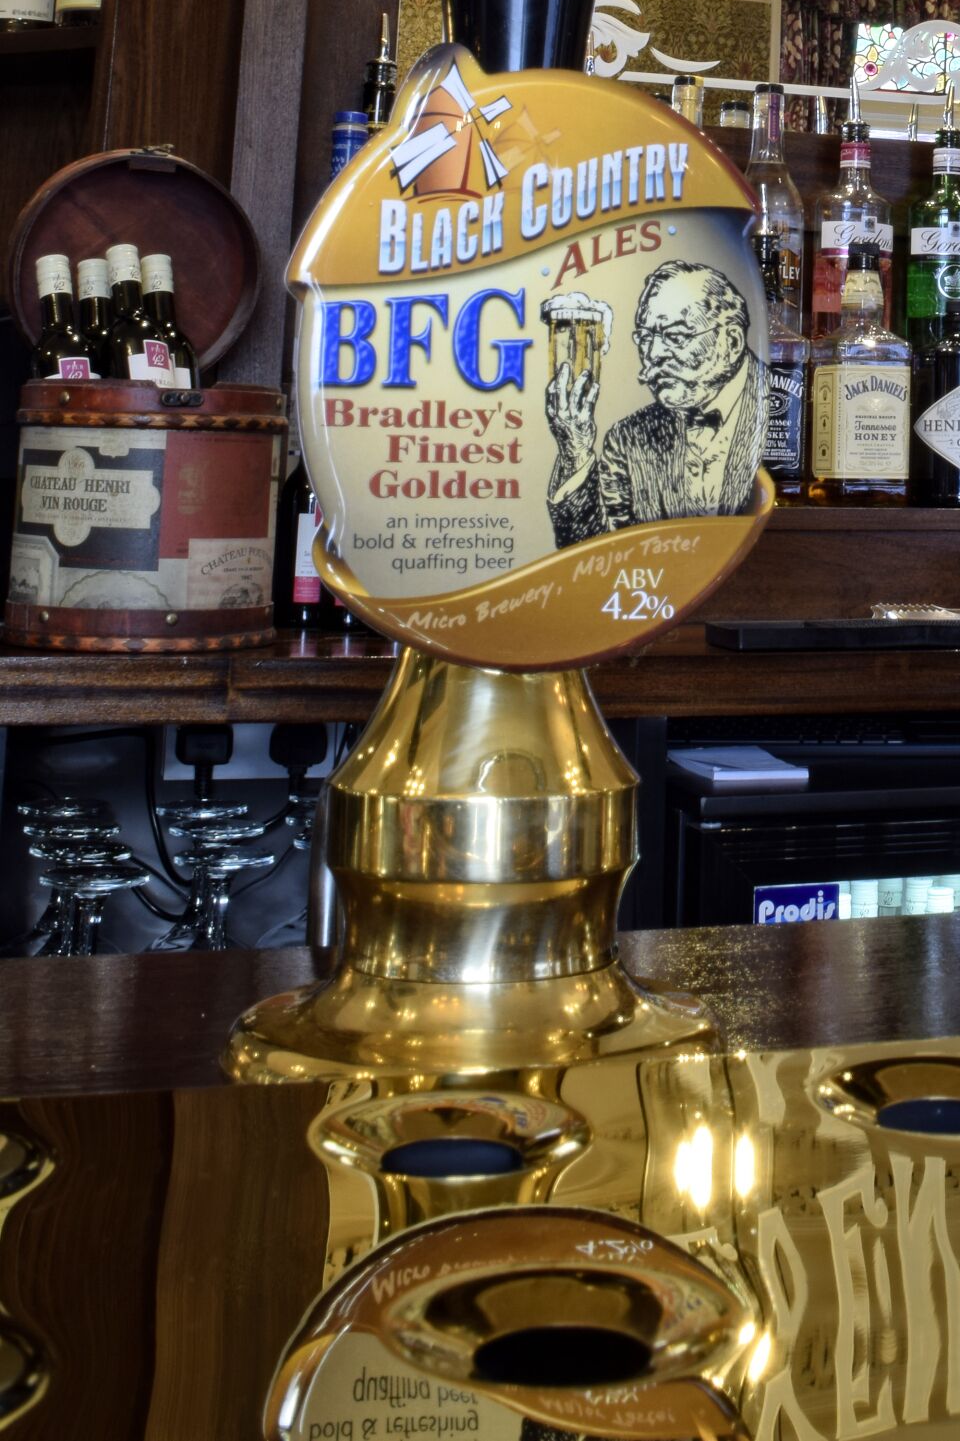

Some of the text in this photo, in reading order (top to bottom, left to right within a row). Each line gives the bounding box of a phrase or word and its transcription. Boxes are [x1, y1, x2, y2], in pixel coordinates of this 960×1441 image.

[378, 143, 689, 274] BLACK COUNTRY
[552, 220, 663, 290] ALES
[318, 288, 534, 391] BFG
[844, 375, 909, 402] JACK DANIEL'S
[321, 399, 524, 435] Bradley's
[854, 420, 897, 431] Tennessee
[387, 435, 523, 464] Finest
[854, 433, 897, 441] HONEY
[30, 477, 131, 494] CHATEAU HENRI
[368, 469, 522, 499] Golden
[41, 496, 108, 512] VIN ROUGE
[386, 514, 515, 535] an impressive,
[353, 533, 514, 555] bold & refreshing
[391, 553, 514, 574] quaffing beer
[407, 534, 702, 632] Micro Brewery, Major Taste!
[613, 568, 664, 590] ABV
[601, 590, 675, 621] 4.2%
[758, 890, 836, 924] Prodis
